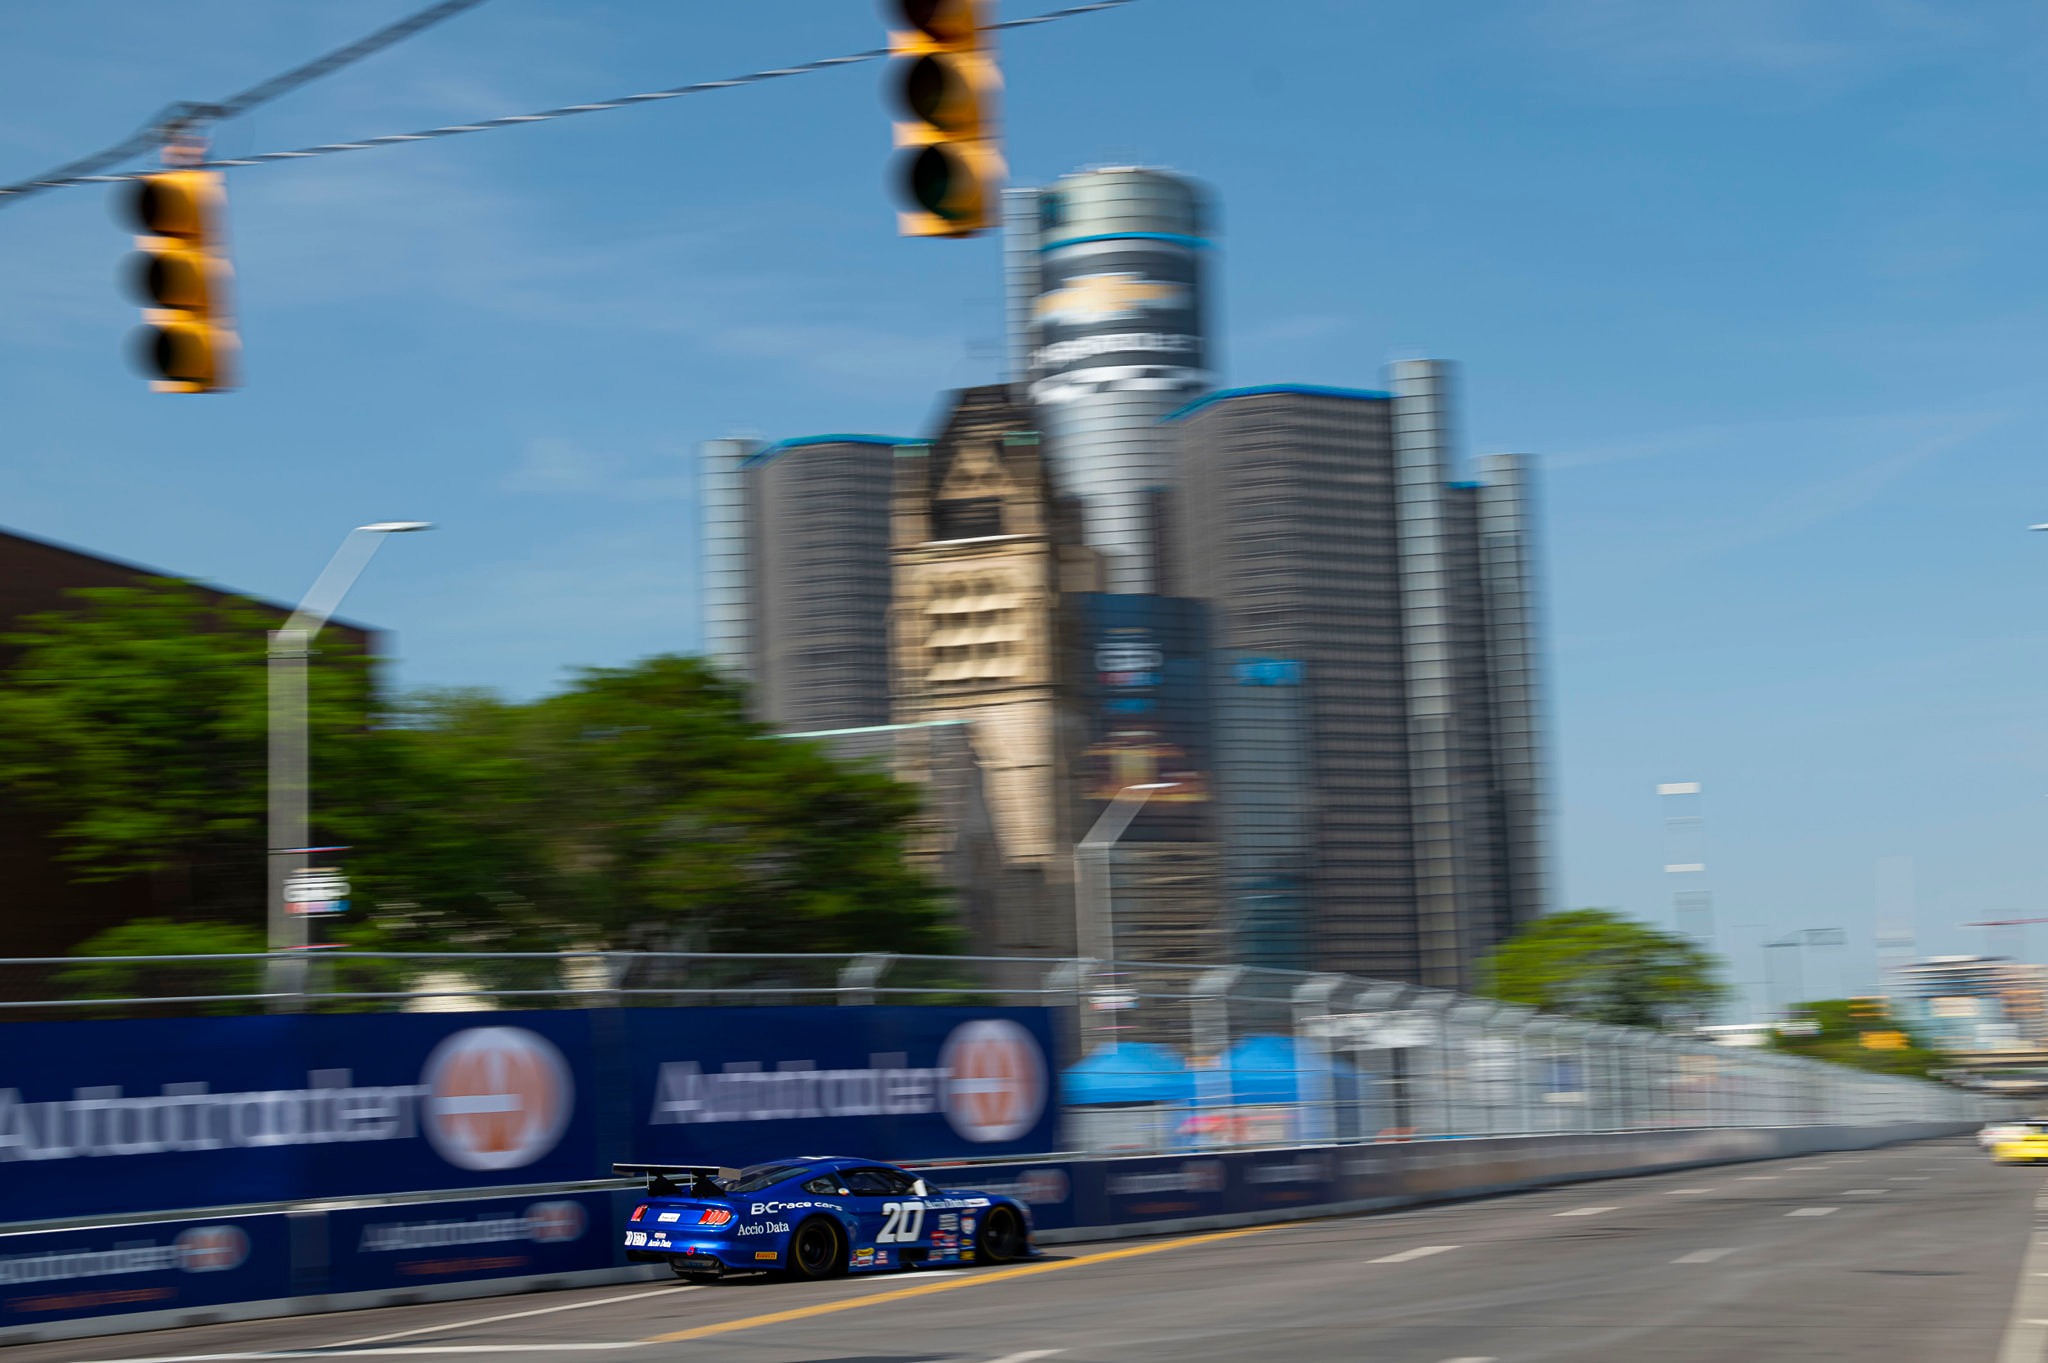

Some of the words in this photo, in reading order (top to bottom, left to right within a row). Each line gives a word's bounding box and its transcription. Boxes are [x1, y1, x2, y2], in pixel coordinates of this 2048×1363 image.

[737, 1222, 764, 1236] Accio
[766, 1221, 790, 1233] Data
[876, 1202, 925, 1243] 20
